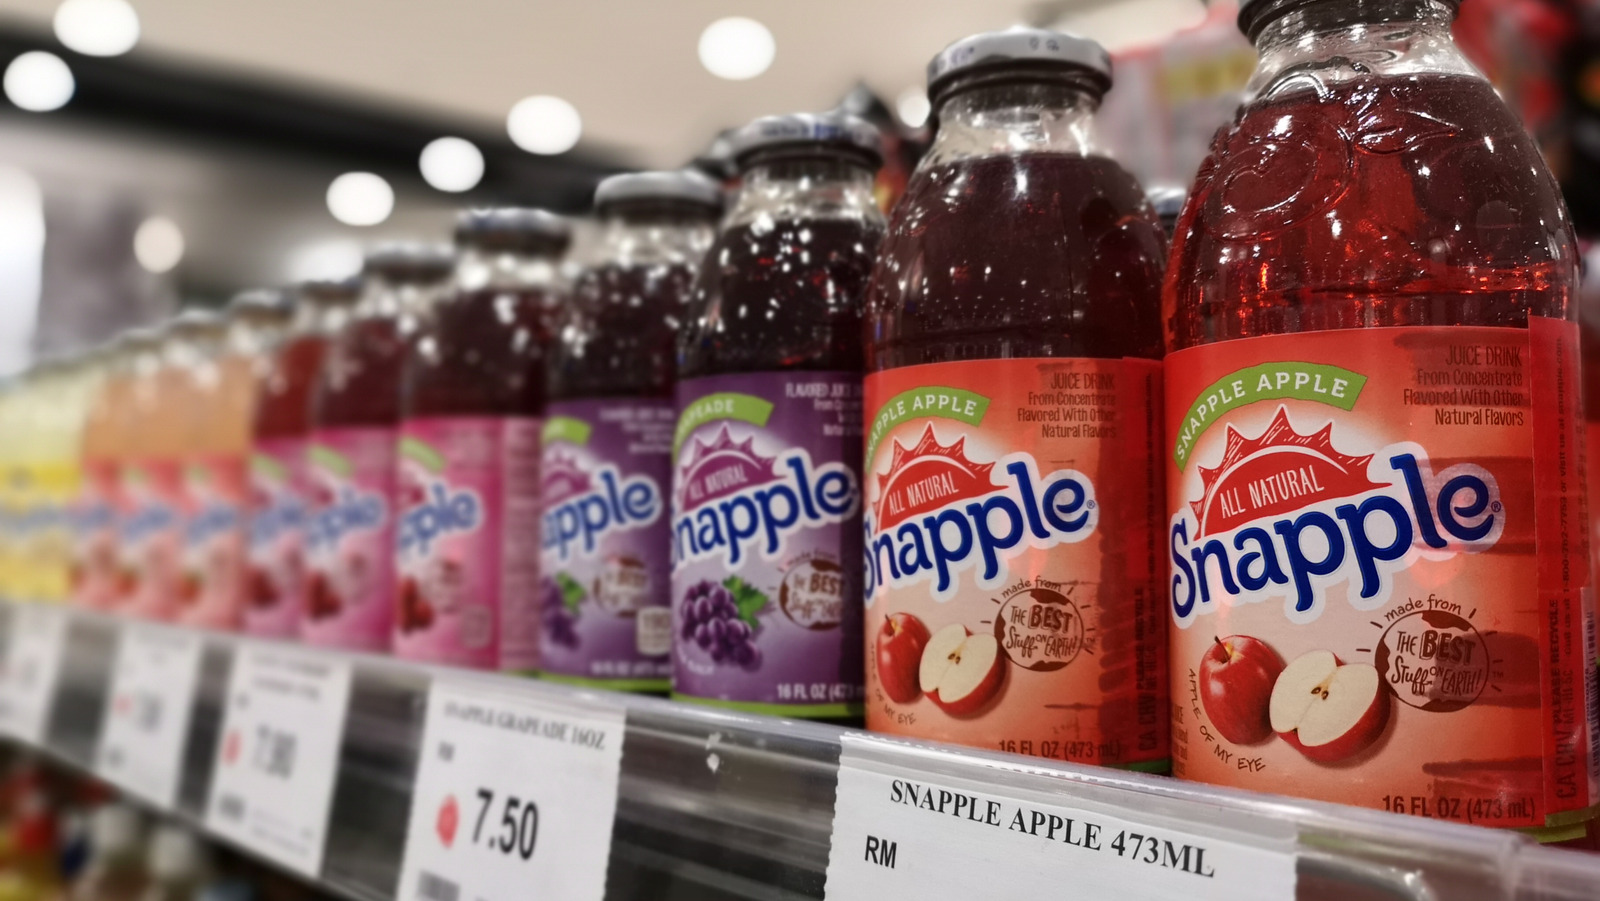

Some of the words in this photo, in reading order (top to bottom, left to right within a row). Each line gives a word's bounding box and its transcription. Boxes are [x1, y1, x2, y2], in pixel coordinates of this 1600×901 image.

[1446, 345, 1481, 366] JUICE
[1486, 346, 1522, 367] DRINK
[1051, 373, 1080, 389] JUICE
[1084, 373, 1115, 390] DRINK
[1417, 368, 1450, 386] From
[1453, 368, 1523, 387] Concentrate
[913, 395, 977, 416] APPLE
[1028, 392, 1053, 406] From
[1056, 392, 1116, 406] Concentrate
[1403, 388, 1457, 406] Flavored
[1460, 388, 1491, 406] With
[1493, 389, 1524, 407] Other
[1018, 408, 1060, 422] Flavored
[1062, 408, 1088, 422] With
[1090, 408, 1116, 422] Other
[1177, 380, 1246, 460] SNAPPLE
[1256, 371, 1348, 398] APPLE
[1435, 408, 1482, 425] Natural
[1485, 408, 1524, 426] Flavors
[1042, 424, 1081, 438] Natural
[1082, 424, 1116, 438] Flavors
[888, 490, 906, 516] ALL
[906, 471, 959, 508] NATURAL
[1221, 491, 1246, 519] ALL
[1248, 465, 1325, 510] NATURAL
[674, 456, 855, 566] napple
[1170, 453, 1494, 619] Snapple
[1002, 578, 1031, 598] made
[1035, 575, 1062, 592] from
[1011, 606, 1028, 626] THE
[1028, 604, 1073, 634] BEST
[1384, 597, 1424, 621] made
[1427, 593, 1462, 615] from
[1006, 626, 1038, 658] Stuff
[1036, 634, 1046, 643] ON
[1044, 636, 1077, 659] EARTH!
[1549, 599, 1560, 663] RECYCLE
[1397, 630, 1418, 656] THE
[1419, 629, 1476, 664] BEST
[1391, 655, 1432, 696] Stuff
[1429, 666, 1442, 677] ON
[1441, 668, 1482, 696] EARTH!
[777, 683, 791, 699] 16
[794, 683, 808, 699] FL
[810, 683, 827, 699] OZ
[1551, 667, 1562, 724] PLEASE
[898, 713, 917, 725] EYE
[1188, 668, 1202, 720] APPLE
[1199, 725, 1215, 742] OF
[1213, 744, 1233, 764] MY
[1237, 757, 1266, 773] EYE
[999, 740, 1016, 753] 16
[1020, 741, 1037, 757] FL
[1041, 741, 1060, 758] OZ
[1065, 741, 1094, 761] (473
[1555, 773, 1577, 799] CA
[1382, 795, 1405, 814] 16
[1410, 796, 1432, 817] FL
[1437, 796, 1461, 818] OZ
[1467, 798, 1504, 823] (473
[1507, 798, 1535, 821] mL)
[472, 787, 539, 861] 7.50
[890, 779, 1001, 827] SNAPPLE
[1008, 807, 1102, 851] APPLE
[1111, 830, 1215, 878] 473ML
[864, 835, 897, 870] RM
